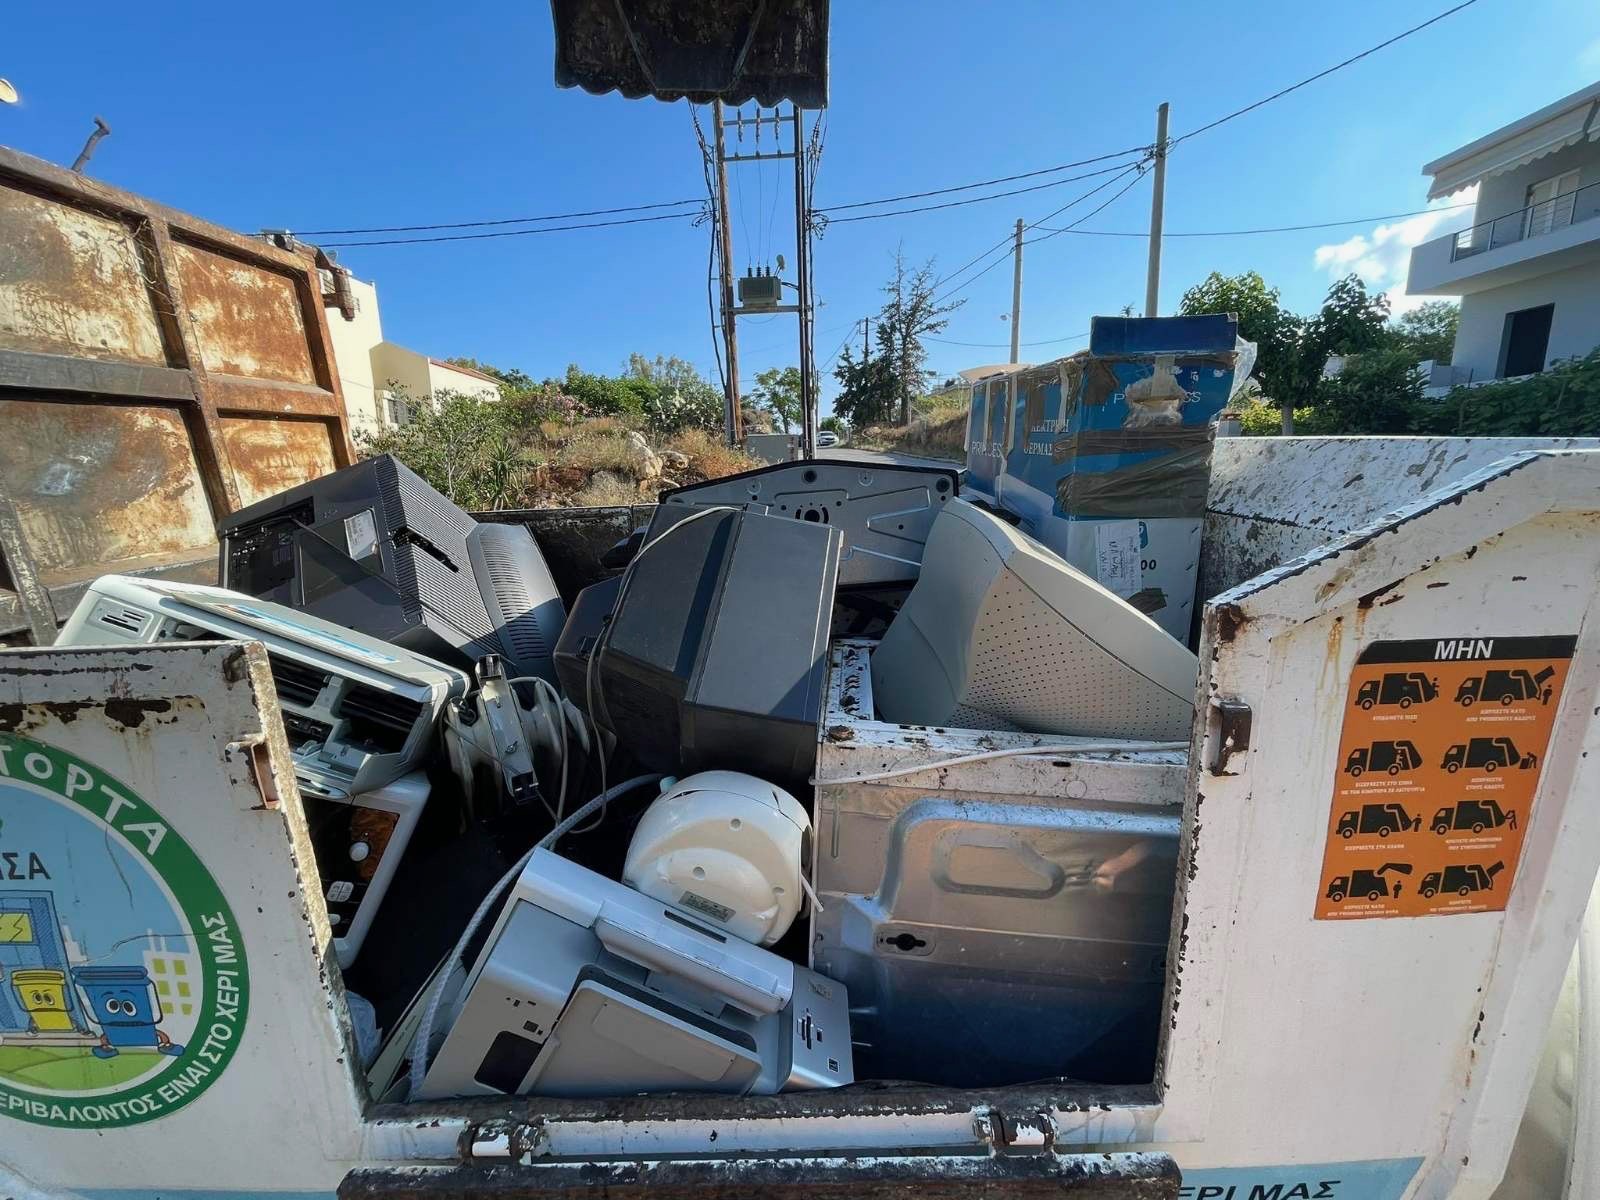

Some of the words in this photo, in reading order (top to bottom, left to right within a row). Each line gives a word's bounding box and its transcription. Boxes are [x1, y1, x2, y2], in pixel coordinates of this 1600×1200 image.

[1434, 639, 1494, 660] ΜΗΝ
[0, 852, 51, 880] ΣΑ
[201, 911, 238, 964] ΜΑΣ
[215, 970, 240, 1022] ΧΕΡΙ
[199, 1023, 232, 1065] ΣΤΟ
[157, 1060, 211, 1104] ΕΙΝΑΙ
[1248, 1180, 1342, 1200] ΜΑΣ
